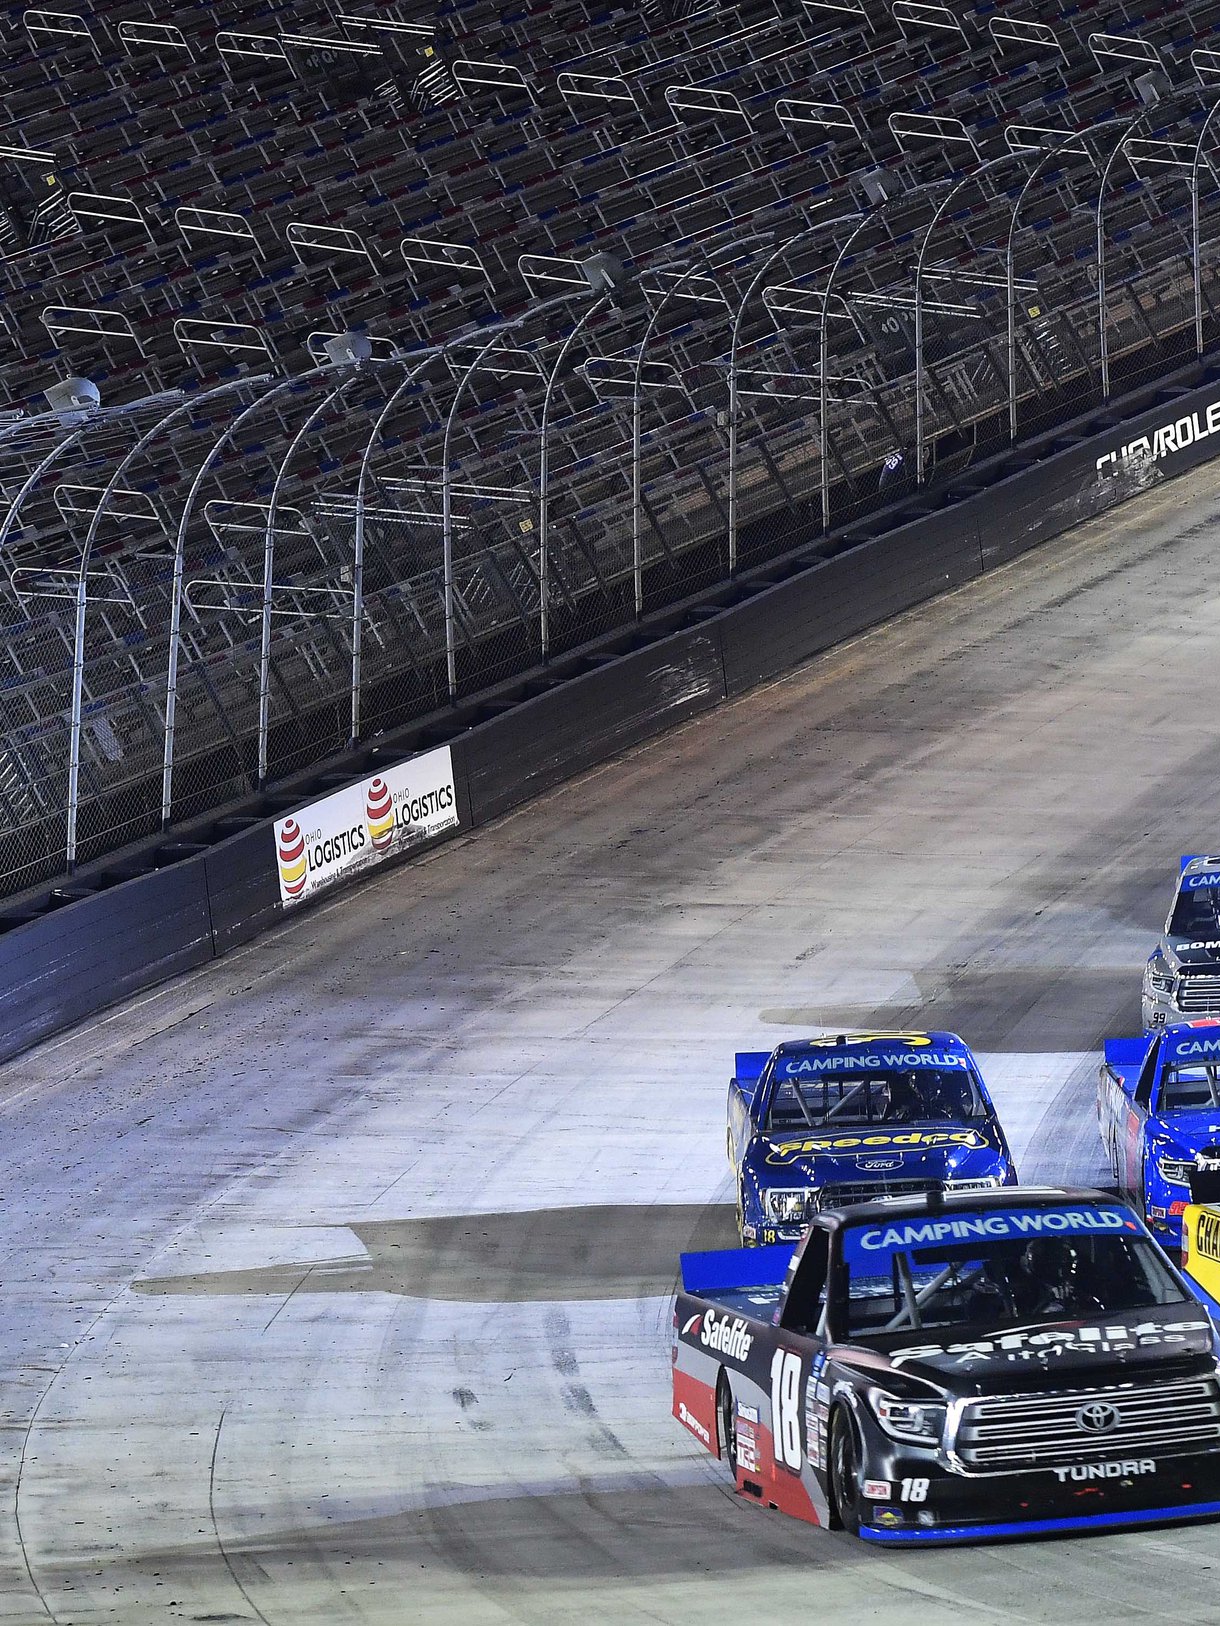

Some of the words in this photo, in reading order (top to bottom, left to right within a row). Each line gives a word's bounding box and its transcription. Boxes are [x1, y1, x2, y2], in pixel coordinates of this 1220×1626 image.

[393, 787, 410, 803] OHIO
[394, 784, 453, 829] LOGISTICS
[305, 829, 321, 845] OHIO
[307, 824, 365, 872] LOGISTICS
[1152, 1012, 1166, 1023] 99
[786, 1056, 881, 1074] CAMPING
[882, 1054, 958, 1066] WORLD
[865, 1159, 895, 1169] Ford
[860, 1218, 1017, 1252] CAMPING
[1019, 1211, 1123, 1233] WORLD
[701, 1309, 751, 1362] Safelite
[889, 1321, 1210, 1368] Safelite
[770, 1347, 802, 1471] 18
[1053, 1460, 1156, 1483] TUNDRA
[901, 1478, 930, 1502] 18
